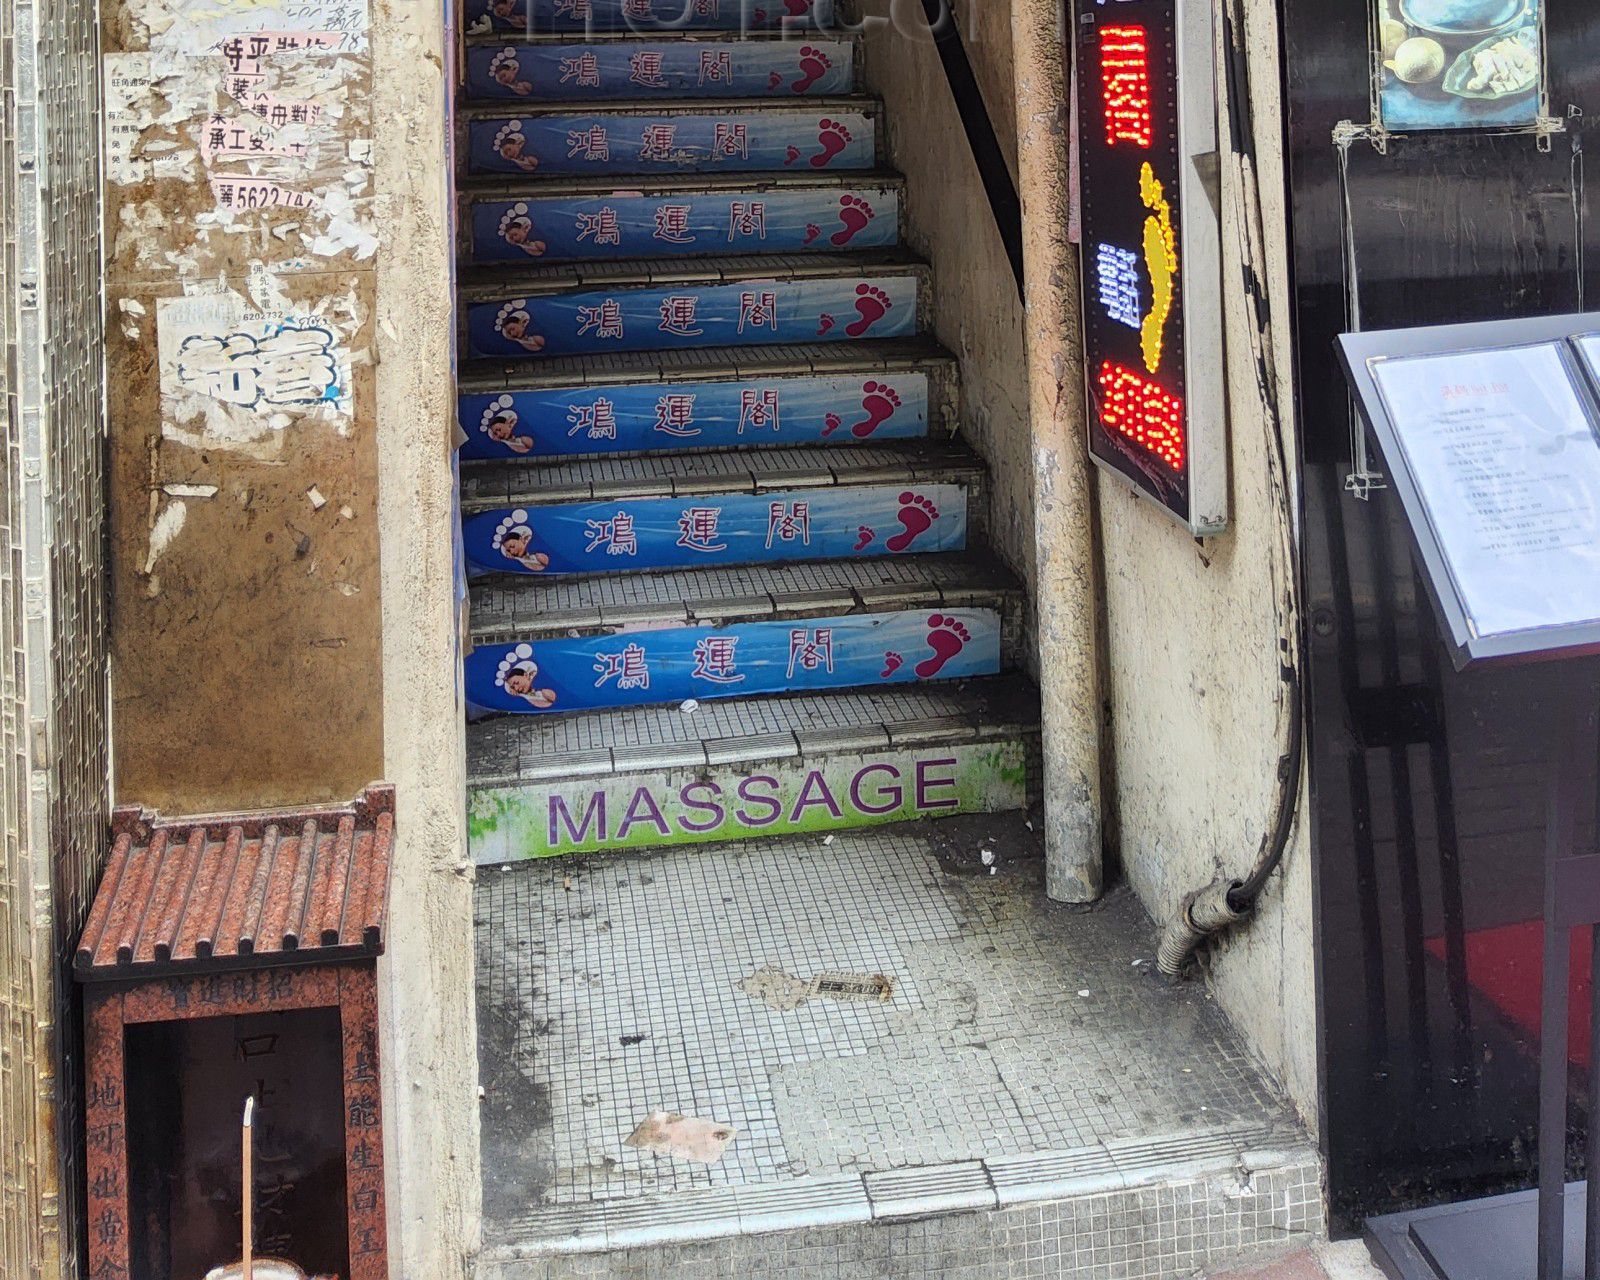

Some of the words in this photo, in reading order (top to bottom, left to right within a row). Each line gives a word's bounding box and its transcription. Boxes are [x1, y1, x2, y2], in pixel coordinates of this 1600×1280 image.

[559, 49, 733, 88] 鴻運閣
[567, 122, 749, 162] 鴻運閣
[575, 200, 766, 246] 鴻運閣
[576, 290, 777, 339] 鴻運閣
[567, 388, 780, 441] 鴻運閣
[585, 500, 811, 557] 鴻運閣
[592, 627, 833, 690] 鴻運閣
[547, 757, 960, 847] MASSAGE
